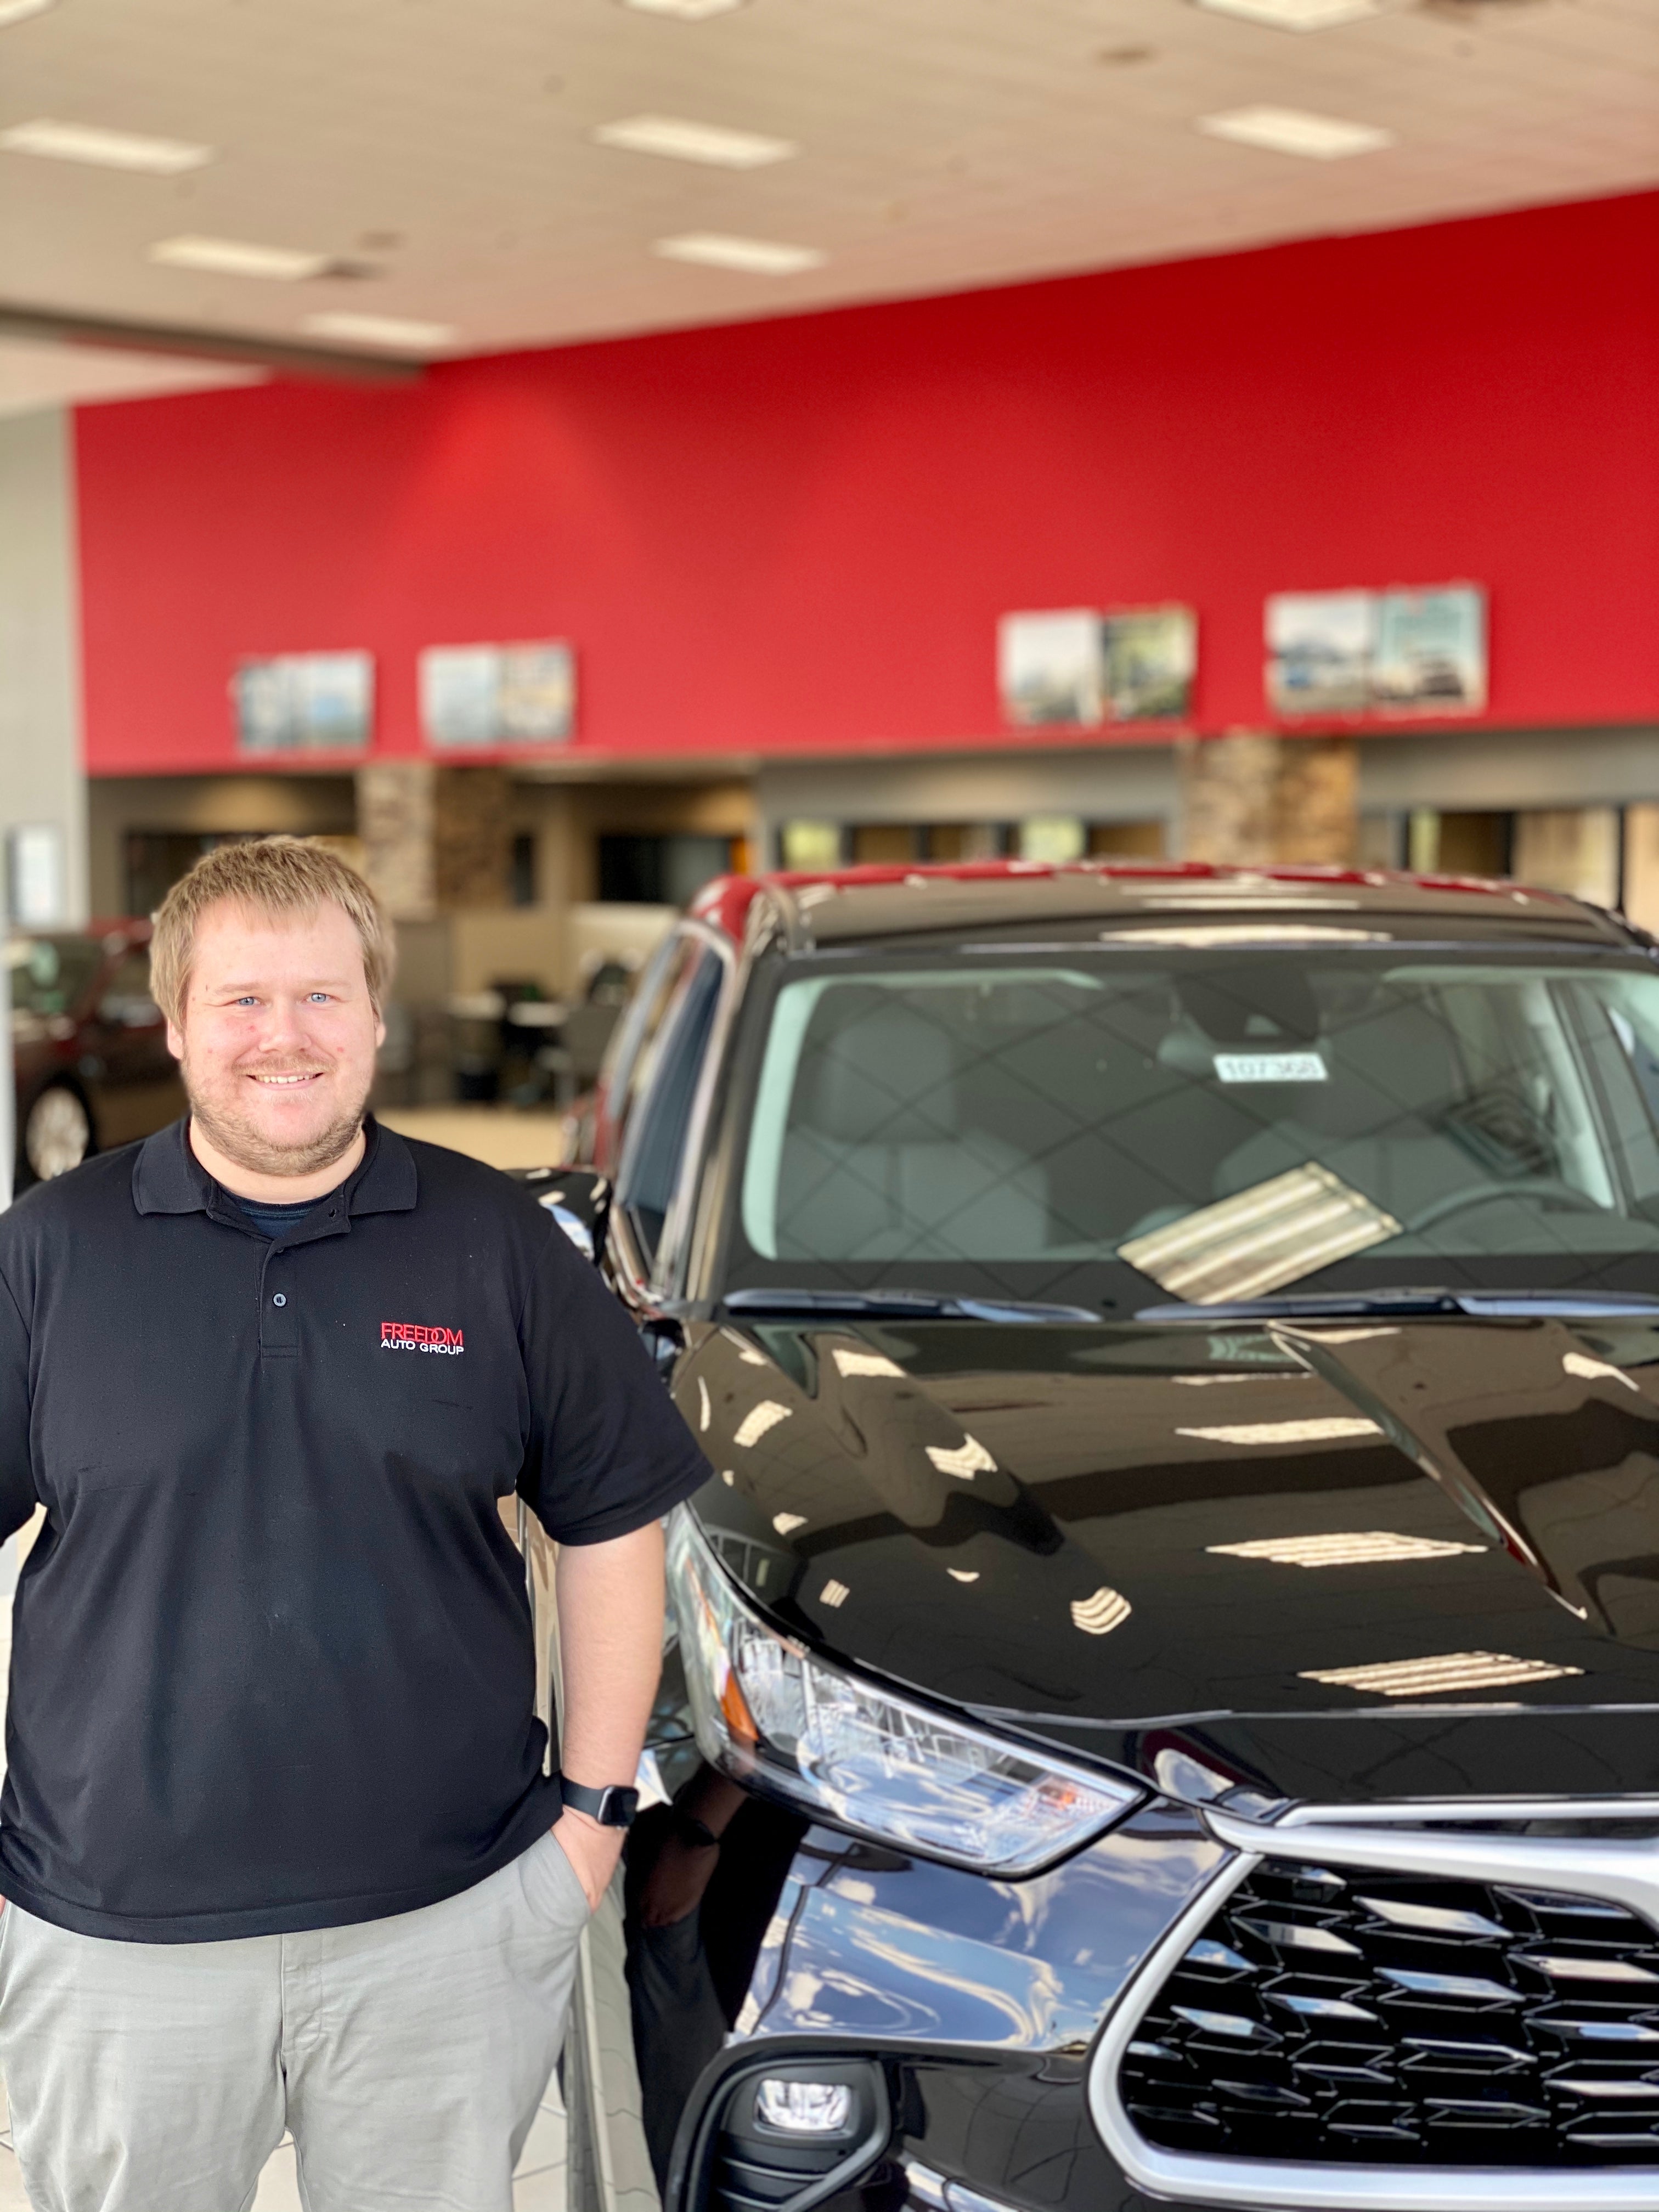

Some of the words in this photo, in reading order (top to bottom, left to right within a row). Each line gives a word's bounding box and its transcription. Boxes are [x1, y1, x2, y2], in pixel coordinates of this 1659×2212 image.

[381, 1322, 464, 1346] FREEDOM
[381, 1339, 416, 1350] AUTO
[420, 1342, 464, 1355] GROUP
